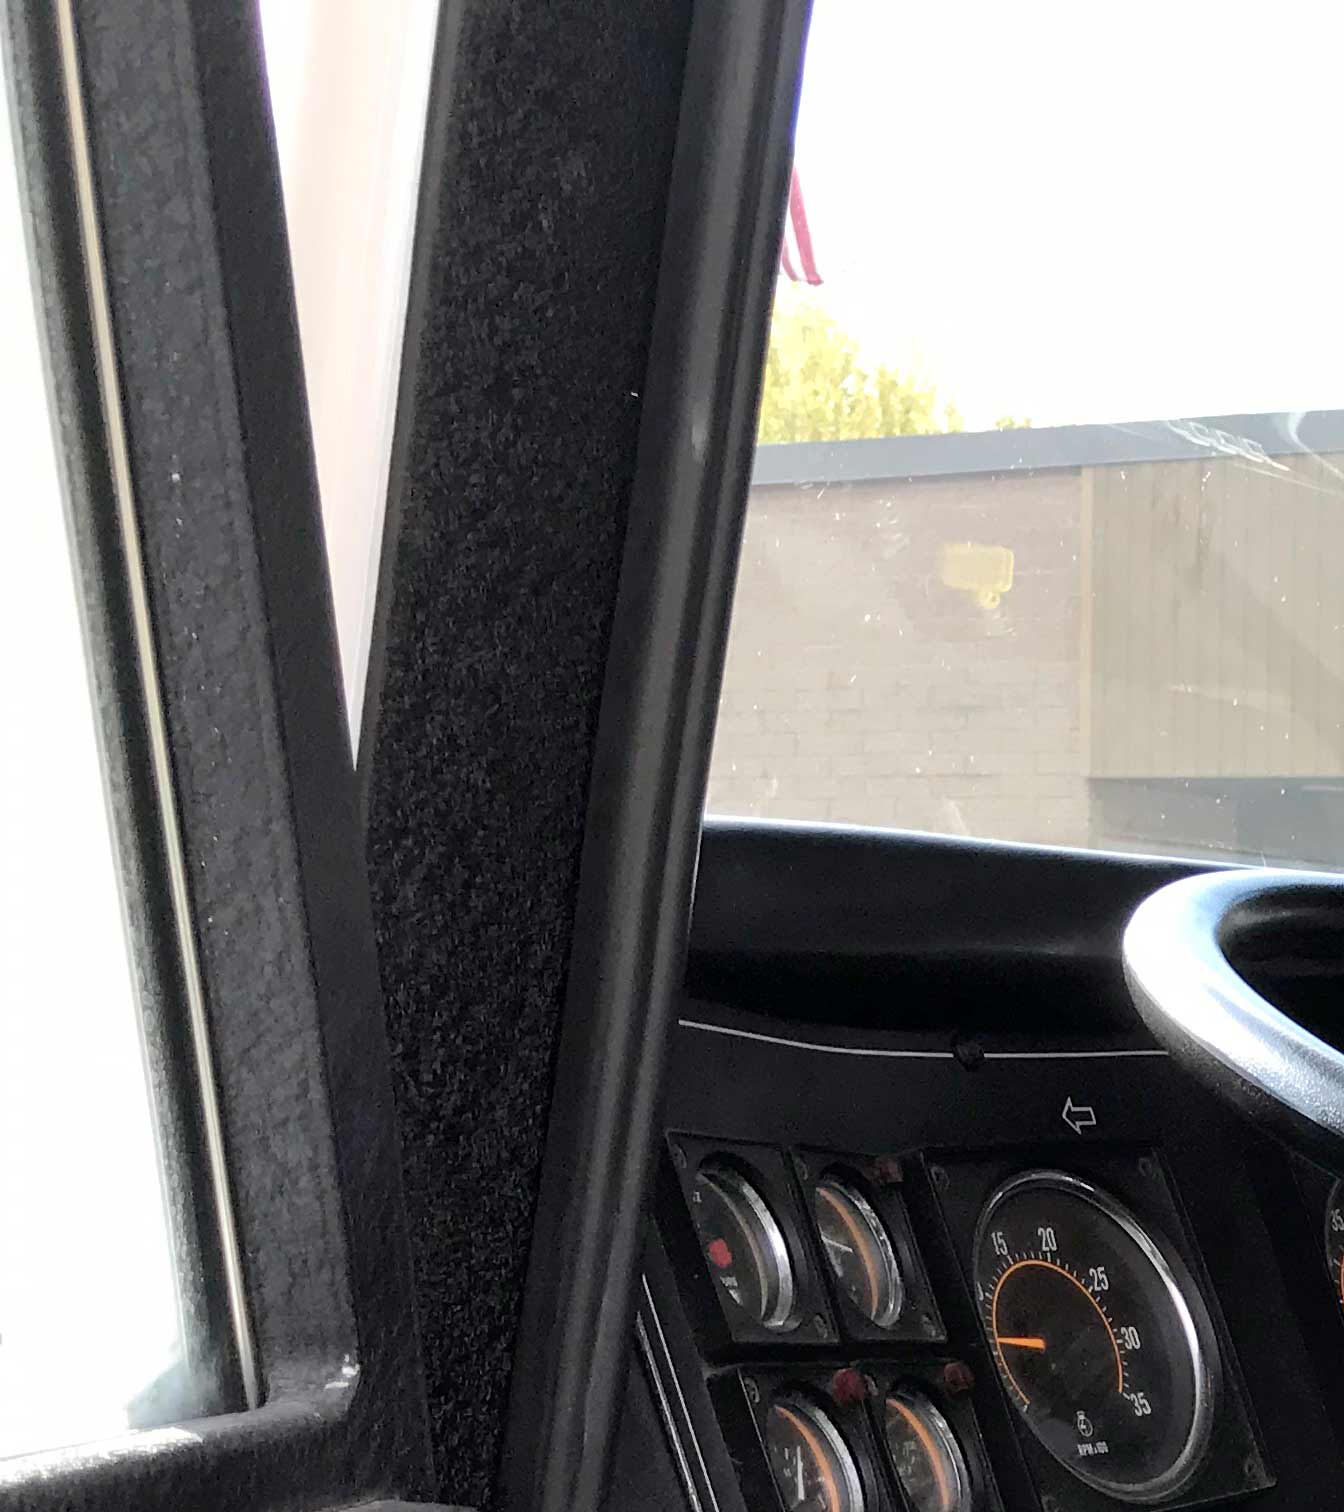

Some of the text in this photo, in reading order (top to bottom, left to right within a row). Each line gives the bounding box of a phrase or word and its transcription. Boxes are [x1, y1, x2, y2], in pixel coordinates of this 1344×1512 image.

[1330, 1208, 1344, 1232] 35
[991, 1232, 1008, 1255] 15
[1038, 1227, 1057, 1251] 20
[1089, 1267, 1109, 1291] 25
[1121, 1327, 1141, 1350] 30
[1131, 1392, 1151, 1416] 35
